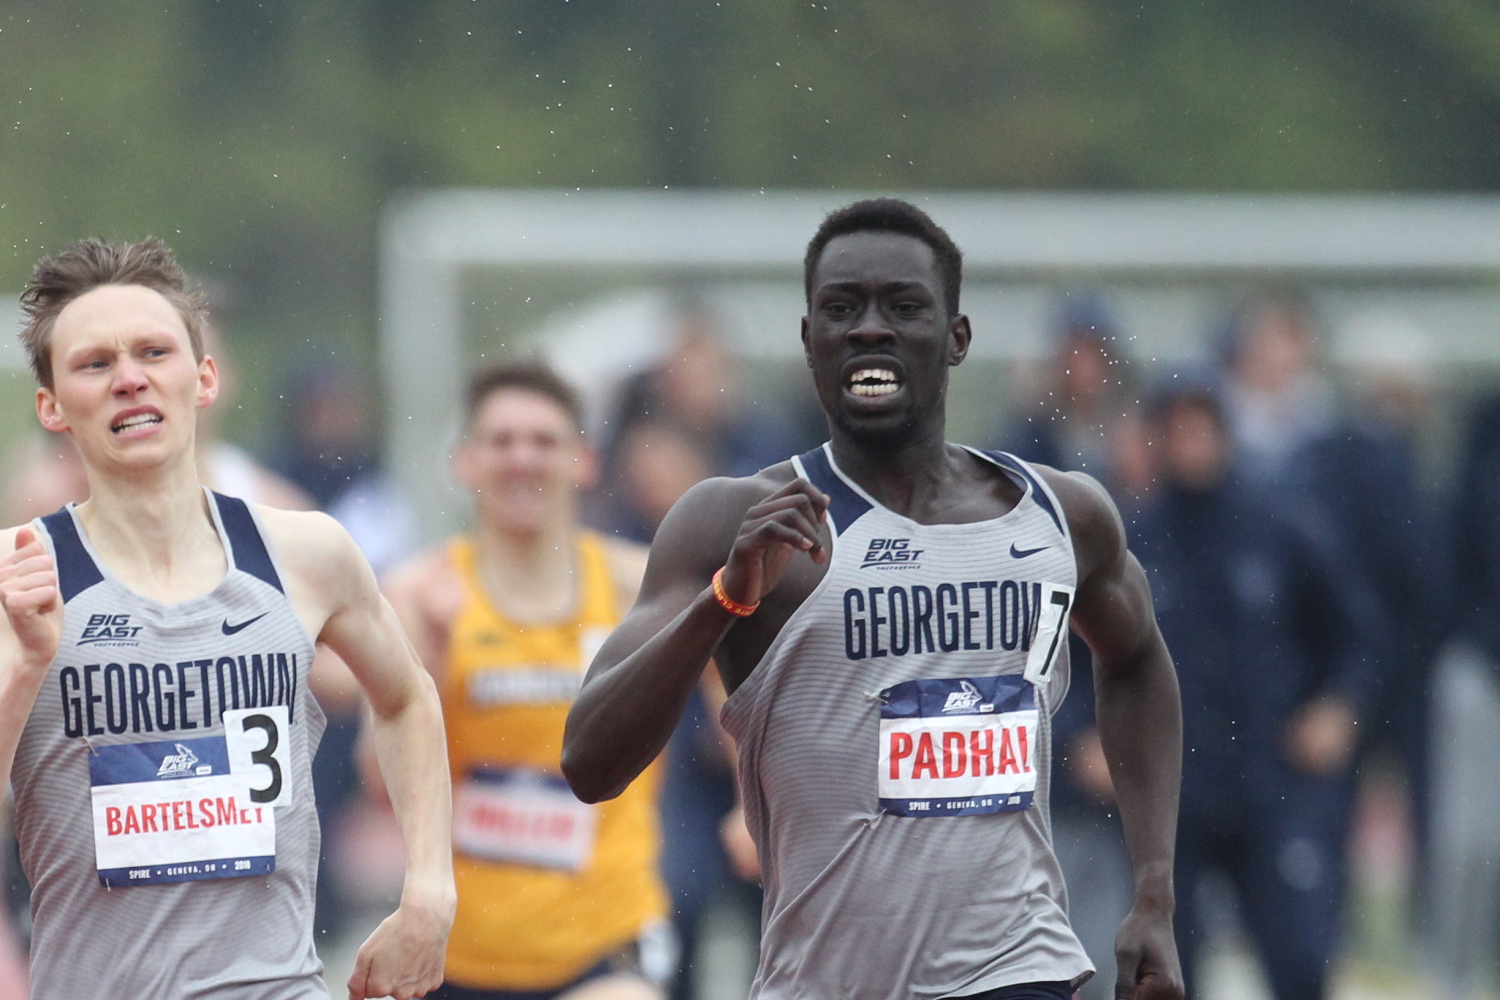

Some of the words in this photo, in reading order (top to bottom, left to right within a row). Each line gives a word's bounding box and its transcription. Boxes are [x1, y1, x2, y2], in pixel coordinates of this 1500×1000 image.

[868, 539, 911, 550] BIG
[863, 550, 925, 562] EAST
[87, 614, 131, 626] BIG
[843, 580, 1042, 661] GEORGETOW
[80, 626, 144, 639] EAST
[1039, 590, 1070, 676] 7
[59, 653, 296, 738] GEORGETOWN
[242, 714, 283, 804] 3
[889, 725, 1031, 780] PADHAL
[908, 801, 931, 811] SPIRE
[128, 869, 151, 879] SPIRE
[167, 866, 202, 876] GENEVA,
[205, 864, 216, 872] OH
[234, 860, 252, 870] 2018
